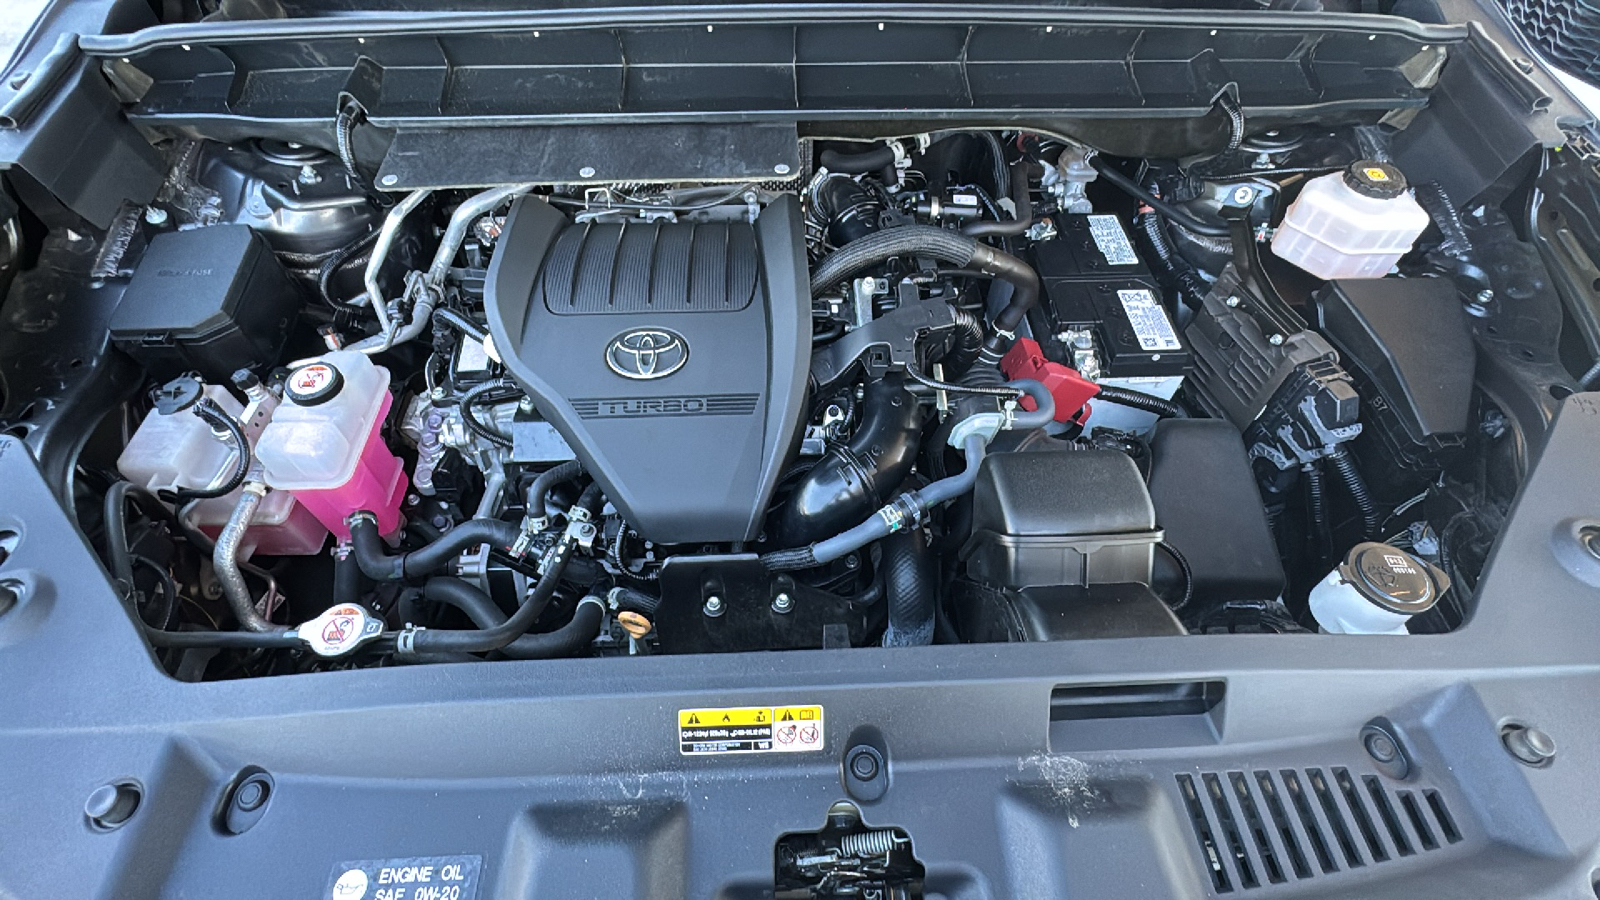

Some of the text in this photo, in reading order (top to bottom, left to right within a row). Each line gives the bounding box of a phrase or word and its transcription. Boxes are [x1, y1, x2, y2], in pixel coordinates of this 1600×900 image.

[601, 398, 704, 414] TURBO
[378, 864, 464, 884] ENGINE OIL
[414, 885, 461, 900] 0W-20
